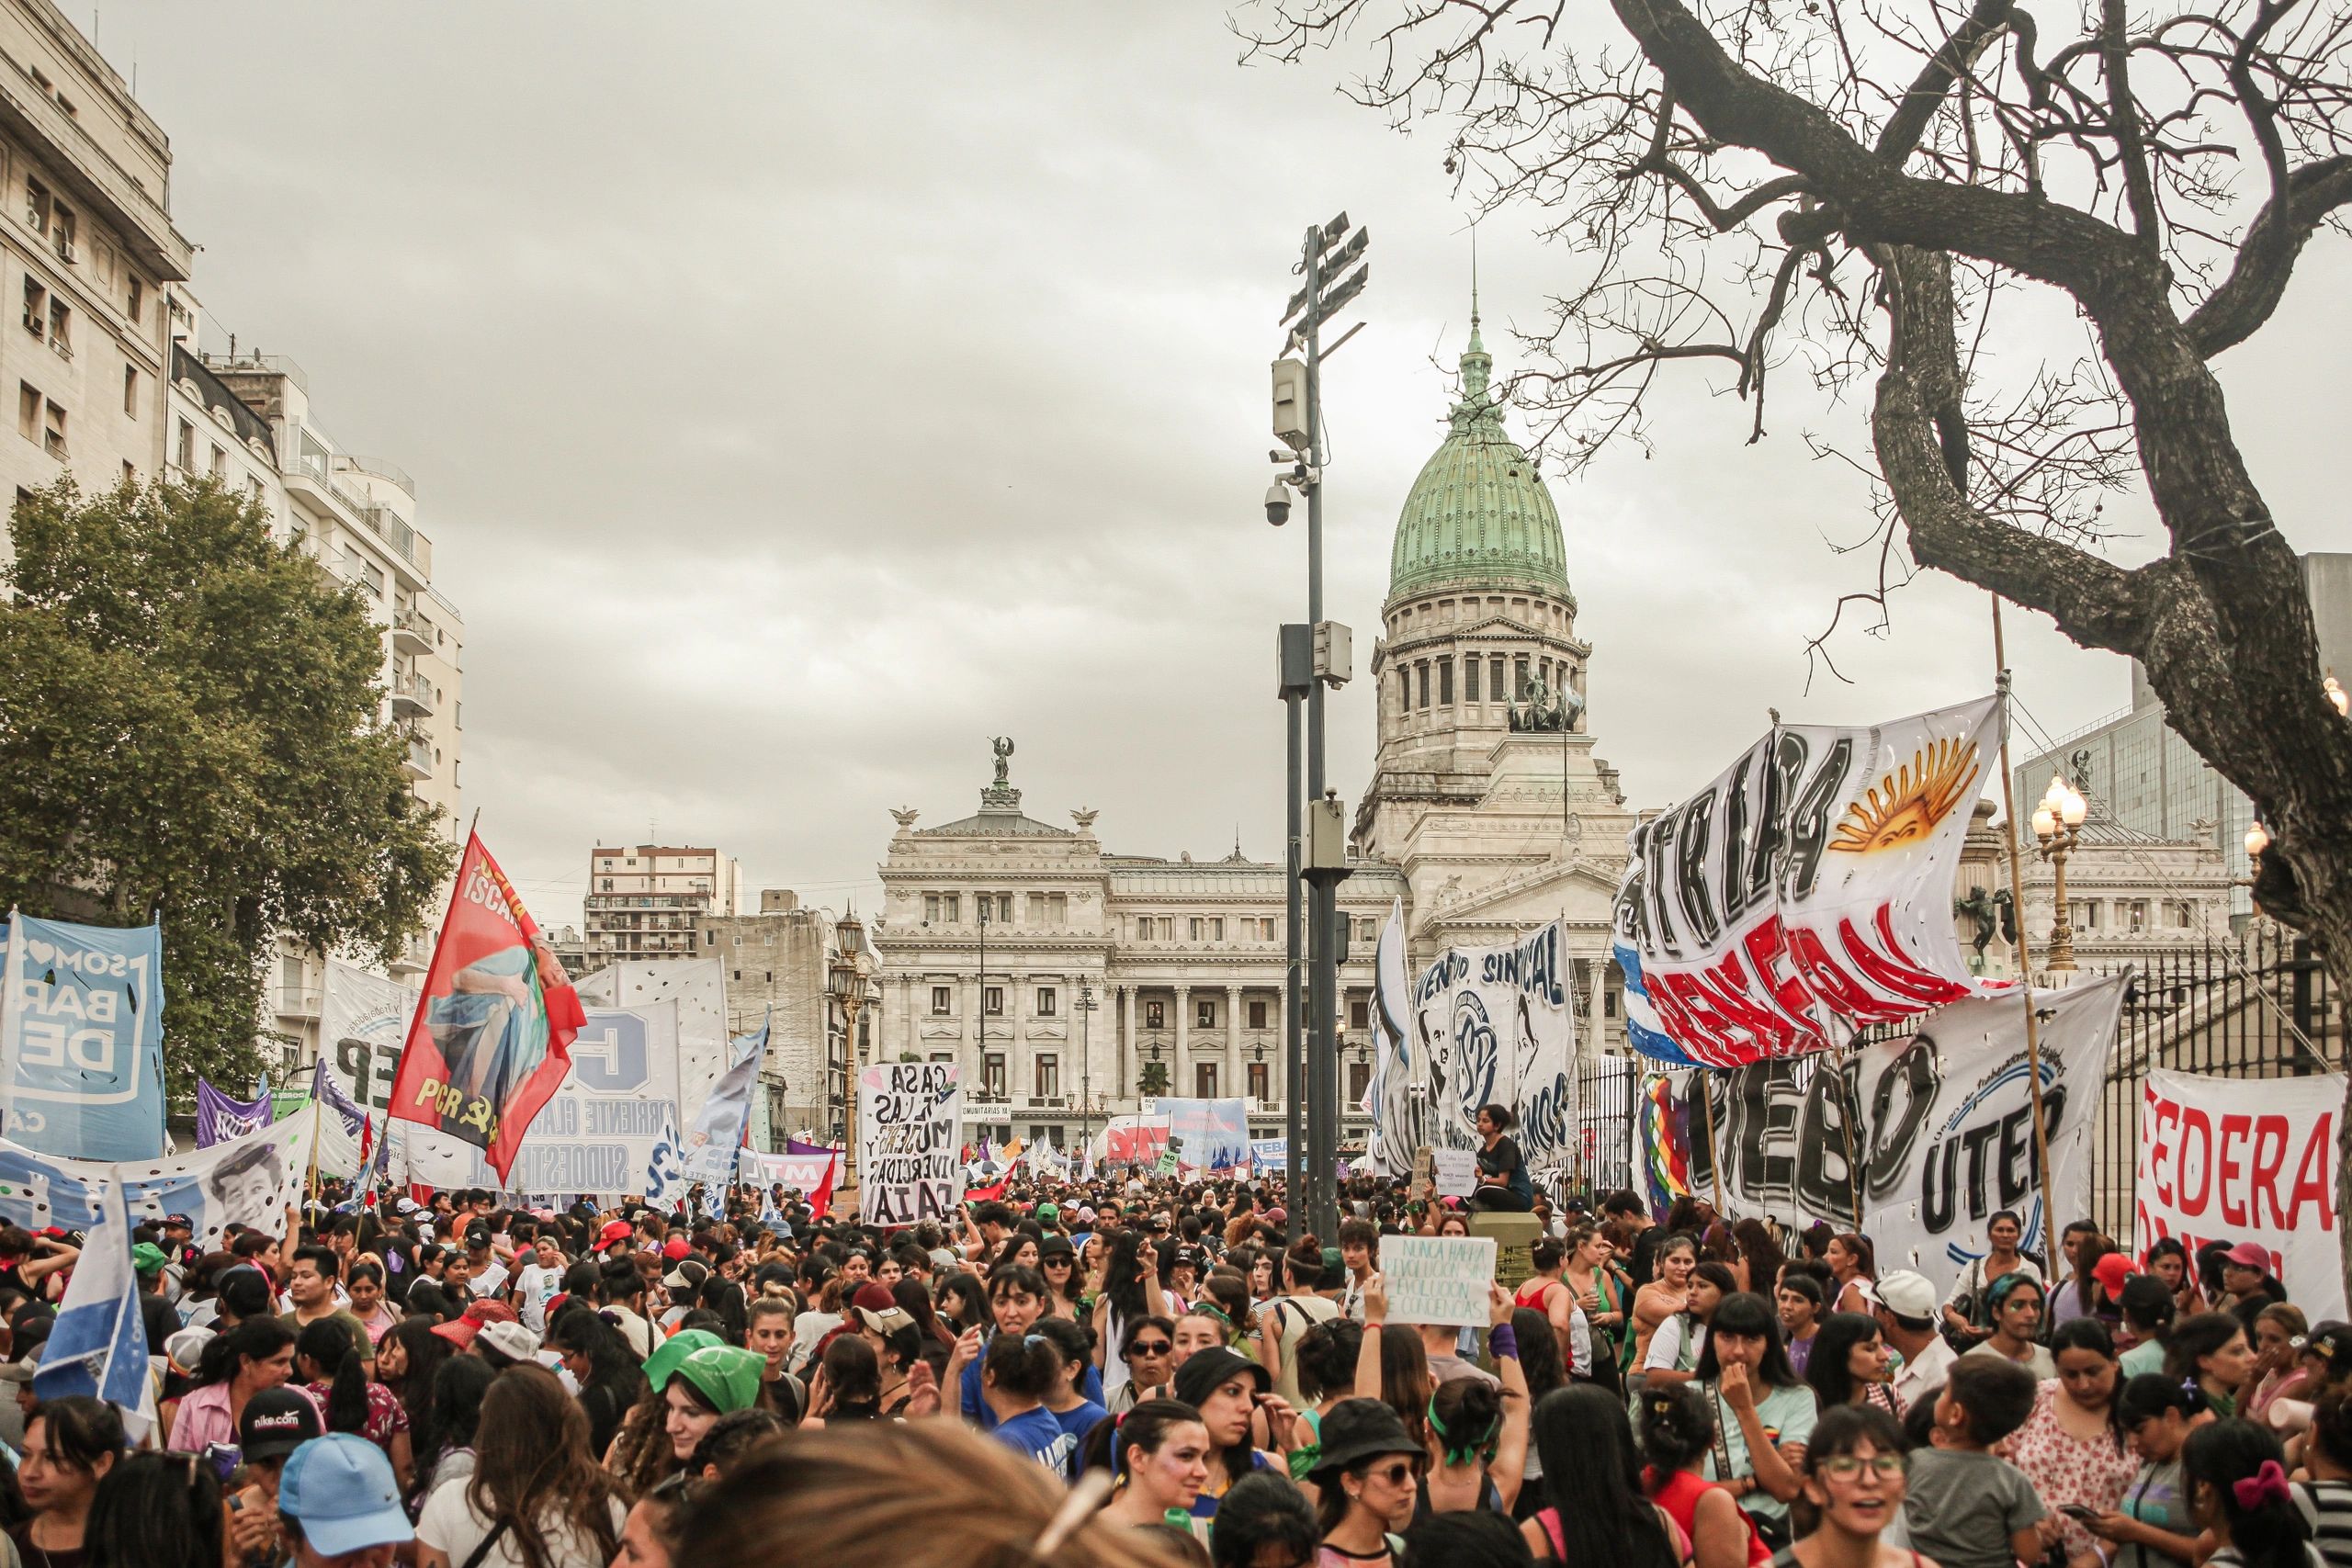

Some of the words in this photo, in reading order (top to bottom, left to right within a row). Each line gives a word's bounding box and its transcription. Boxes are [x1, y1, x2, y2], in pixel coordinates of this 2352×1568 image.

[415, 1077, 463, 1119] PCR
[1163, 1153, 1175, 1161] NO
[1922, 1084, 2067, 1235] UTEP
[2138, 1079, 2336, 1232] FEDERA
[254, 1414, 300, 1428] nike.com
